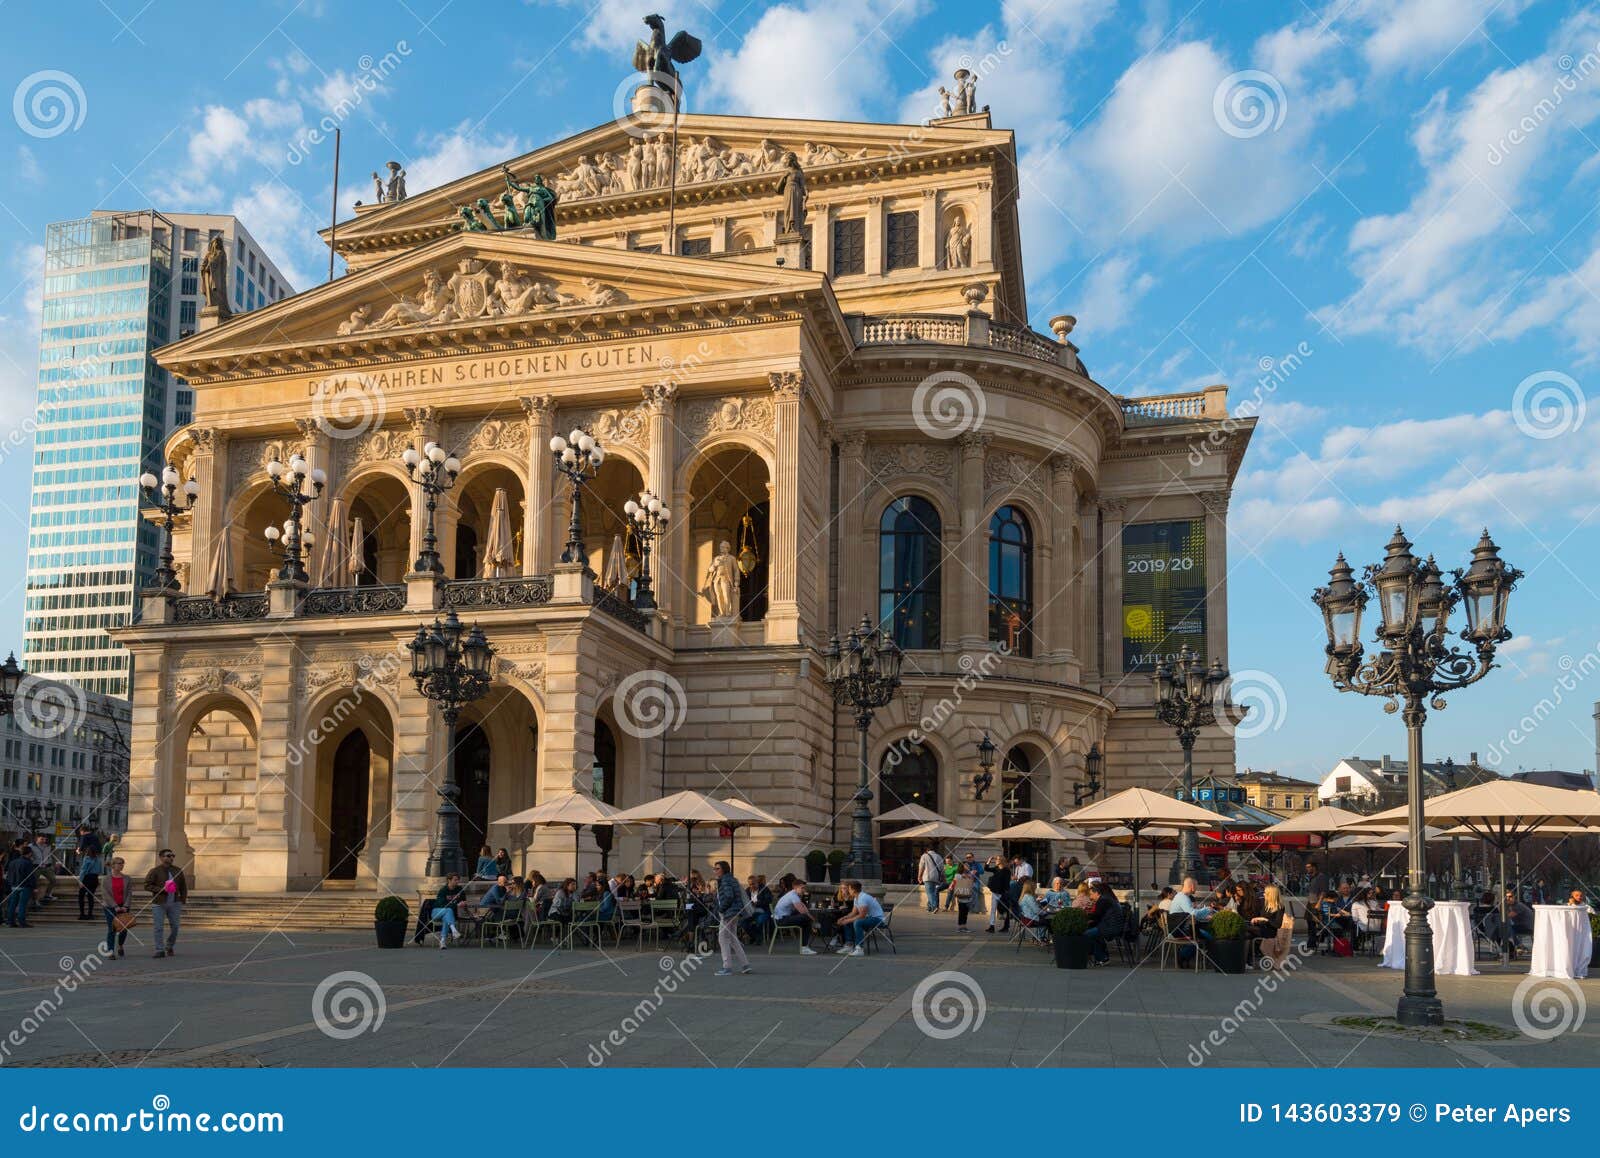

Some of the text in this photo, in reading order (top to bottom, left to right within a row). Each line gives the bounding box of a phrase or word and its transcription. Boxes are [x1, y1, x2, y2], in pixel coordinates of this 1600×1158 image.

[309, 379, 348, 397] DEM
[358, 367, 443, 391] WAHREN
[455, 353, 568, 382] SCHOENEN
[1127, 556, 1194, 574] 2019/20
[1202, 791, 1210, 801] P
